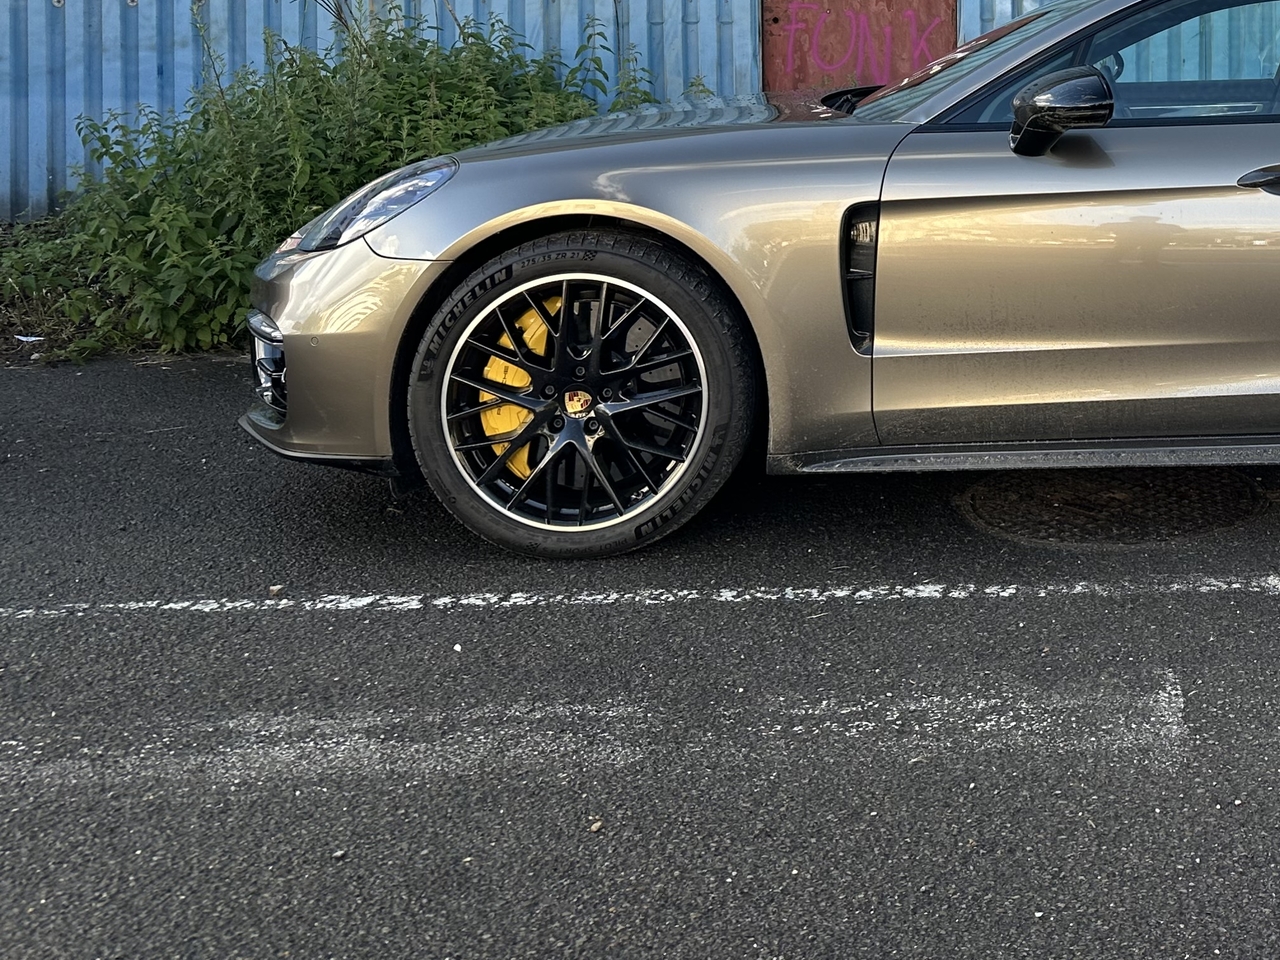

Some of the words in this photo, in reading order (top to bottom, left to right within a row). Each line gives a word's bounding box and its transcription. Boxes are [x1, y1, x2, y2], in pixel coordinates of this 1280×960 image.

[782, 0, 942, 87] FUNK
[428, 267, 509, 357] MICHELIN
[640, 451, 718, 536] MICHELIN
